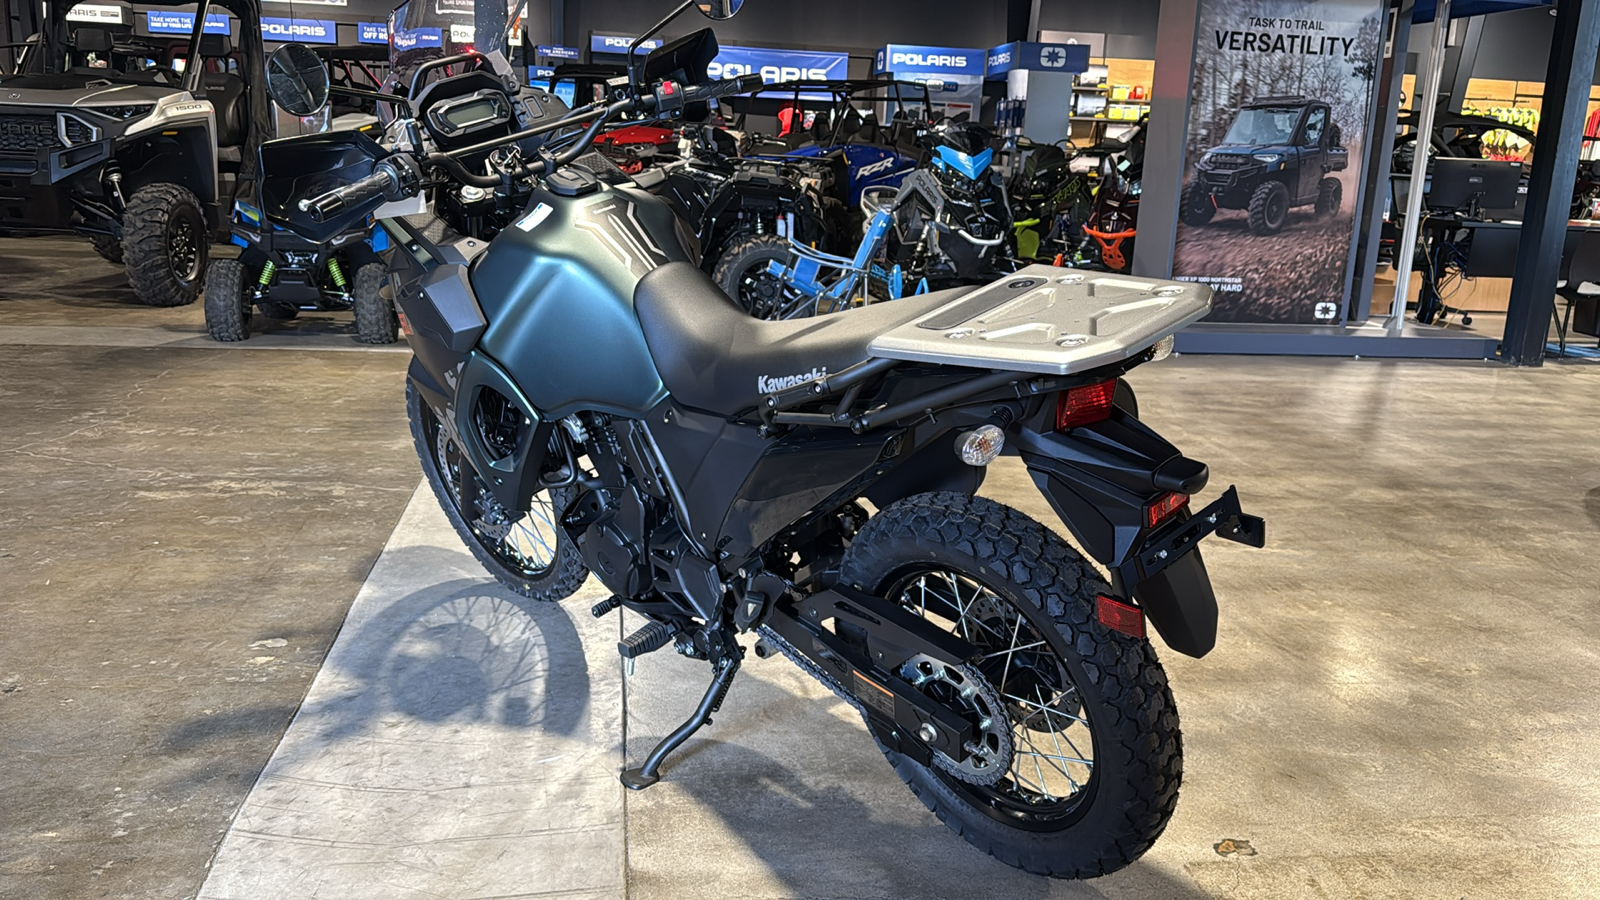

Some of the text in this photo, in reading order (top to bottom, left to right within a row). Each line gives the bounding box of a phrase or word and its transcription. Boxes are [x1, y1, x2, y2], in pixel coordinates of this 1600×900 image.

[69, 9, 97, 17] ARIS
[260, 23, 326, 37] POLARIS
[1249, 16, 1325, 31] TASK TO TRAIL
[363, 31, 377, 39] OFF
[605, 38, 657, 49] POLIS
[1215, 30, 1355, 57] VERSATILITY
[892, 53, 967, 67] POLARIS
[988, 51, 1011, 67] POLARIS
[175, 104, 202, 112] 1500
[8, 123, 54, 136] ARIS
[855, 157, 895, 181] RZR
[915, 174, 938, 204] POLARIS
[1220, 283, 1243, 292] HARD
[758, 366, 827, 394] Kawasaki
